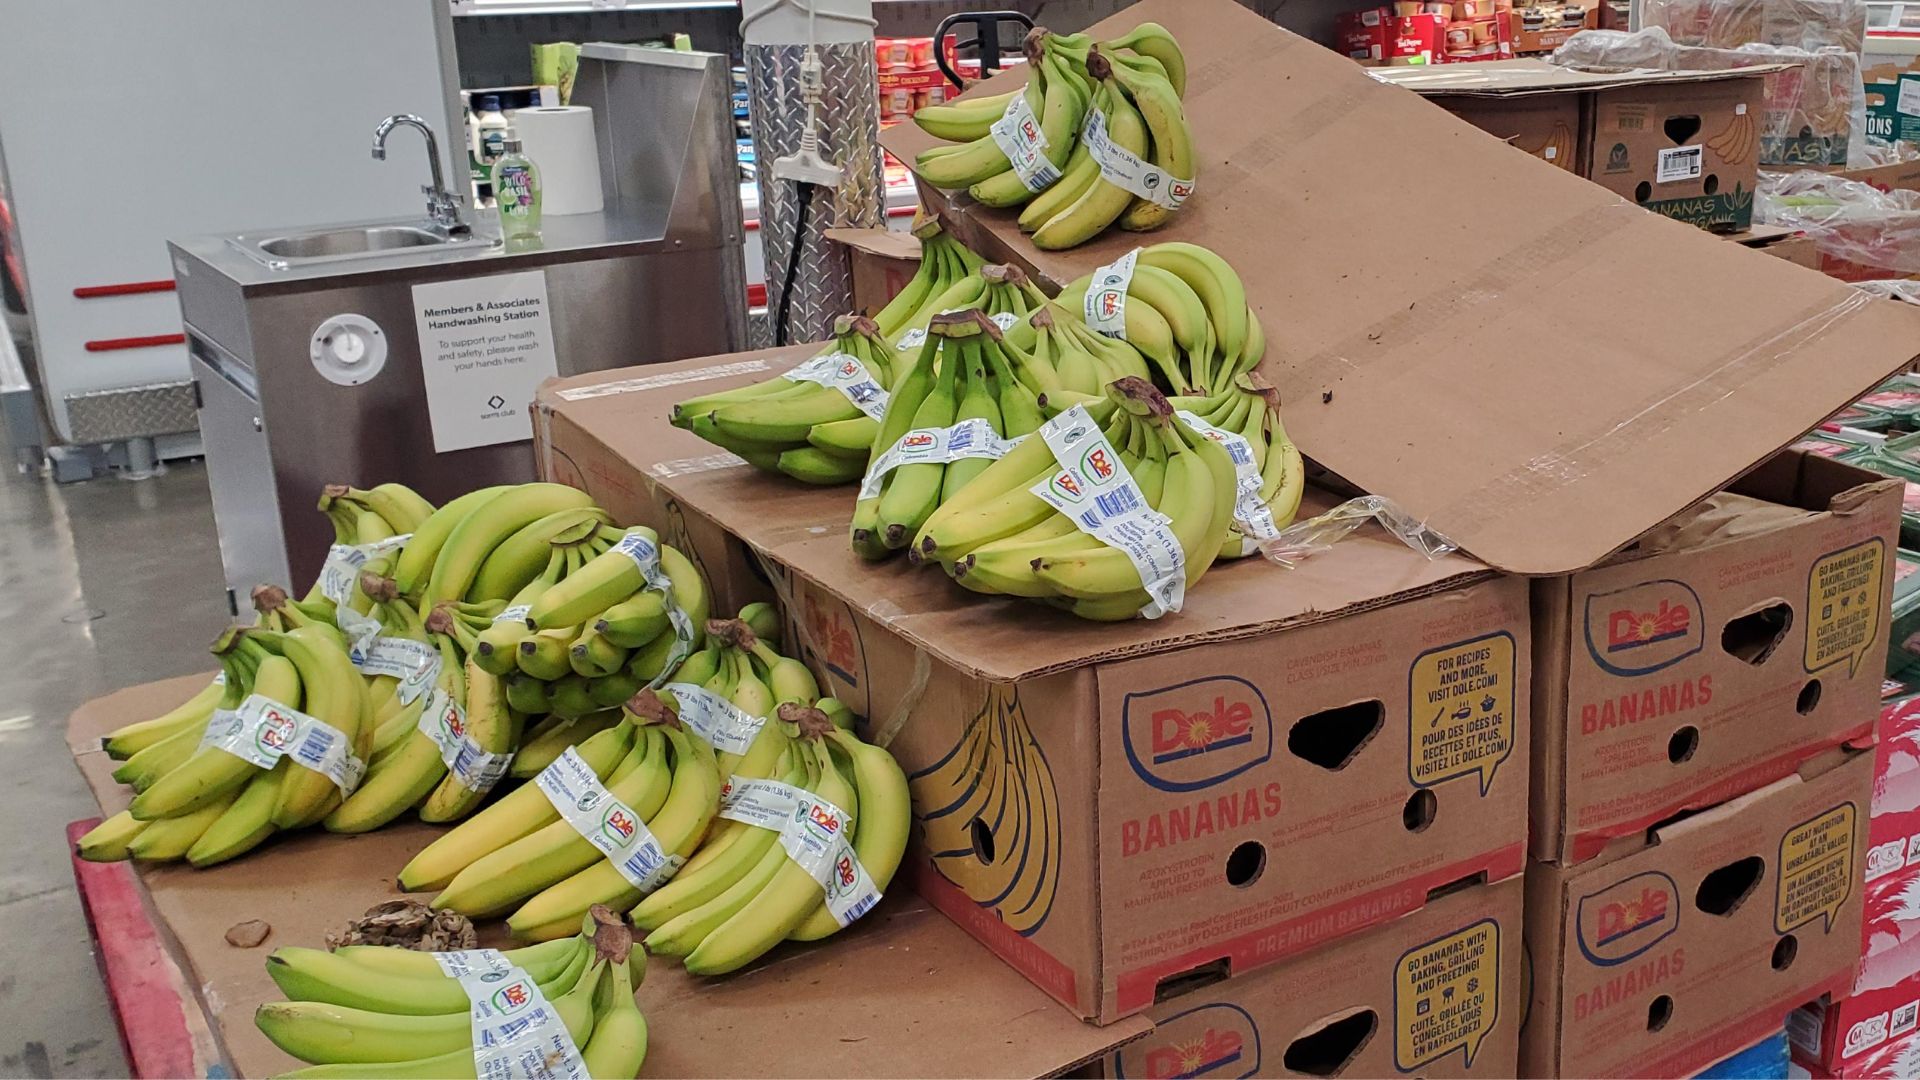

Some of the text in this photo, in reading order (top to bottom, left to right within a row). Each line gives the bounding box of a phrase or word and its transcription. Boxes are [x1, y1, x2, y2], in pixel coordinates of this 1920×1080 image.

[1651, 199, 1715, 216] ANANAS
[424, 297, 540, 318] Members & Associates
[1105, 293, 1118, 315] Dole
[428, 310, 539, 330] Handwashing Station
[438, 352, 455, 361] and
[487, 345, 515, 356] please
[518, 342, 538, 352] wash
[440, 330, 535, 349] To support your health
[454, 363, 473, 373] your
[476, 358, 502, 368] hands
[501, 409, 516, 417] club
[1090, 449, 1112, 477] Dole
[1608, 599, 1690, 646] Dole
[1437, 648, 1490, 672] FOR RECIPES
[1428, 674, 1498, 703] VISIT DOLE.COM!
[1440, 672, 1458, 686] AND
[1582, 673, 1712, 735] BANANAS
[1152, 696, 1253, 752] Dole
[1422, 712, 1502, 747] POUR DES IDÉES DE
[1416, 739, 1508, 777] VISITEZ LE DOLE.COM!
[1423, 739, 1464, 760] RECETTES
[1466, 735, 1476, 748] ET
[610, 810, 634, 839] Dole
[810, 804, 839, 834] Dole
[1122, 782, 1282, 857] BANANAS
[1792, 828, 1811, 846] GREAT
[838, 856, 855, 887] Dole
[1140, 852, 1216, 882] AZOXYSTROBIN
[1193, 868, 1206, 879] TO
[1124, 890, 1174, 910] MAINTAIN
[1202, 922, 1233, 942] DOLE
[1233, 908, 1268, 931] FRESH
[1270, 901, 1300, 919] FRUIT
[1302, 882, 1354, 907] COMPANY
[1256, 912, 1334, 956] PREMIUM
[1337, 888, 1412, 928] BANANAS
[1598, 887, 1668, 942] Dole
[1408, 930, 1488, 972] GO BANANAS WITH
[1448, 944, 1484, 968] GRILLING
[1416, 960, 1480, 996] AND FREEZING!
[1574, 948, 1686, 1022] BANANAS
[506, 984, 526, 1008] Dole
[1440, 996, 1471, 1020] GRILLÉE
[1473, 992, 1485, 1006] OU
[1460, 1006, 1482, 1024] VOUS
[551, 1034, 564, 1052] Net
[1414, 1018, 1481, 1058] EN RAFFOLEREZ!
[1145, 1028, 1243, 1080] Dole
